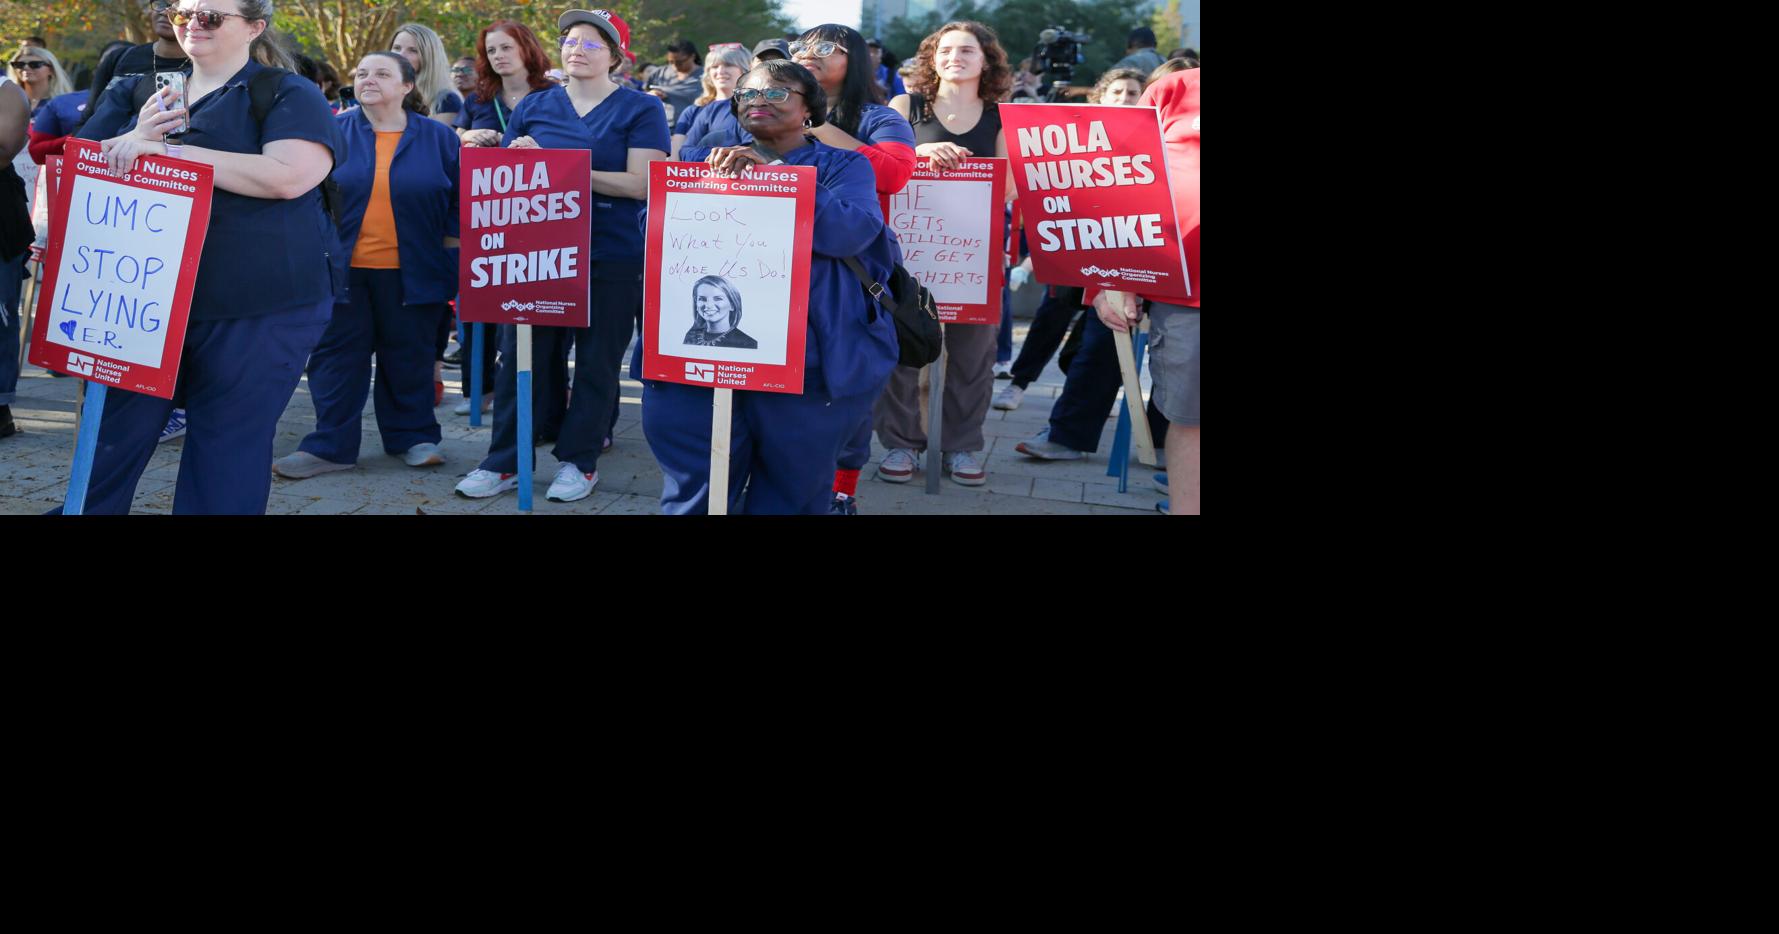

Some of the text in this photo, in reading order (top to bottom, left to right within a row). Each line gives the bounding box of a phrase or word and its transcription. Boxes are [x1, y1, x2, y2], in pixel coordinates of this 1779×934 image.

[1017, 120, 1112, 158] NOLA
[79, 148, 198, 181] Natl Nurses
[959, 162, 994, 170] urses
[1024, 154, 1155, 191] NURSES
[77, 162, 196, 192] Organig Committee
[471, 161, 550, 197] NOLA
[740, 169, 798, 182] Nurses
[912, 170, 993, 179] nizing Committee
[666, 180, 797, 193] Organizing Committee
[86, 191, 168, 232] UMC
[471, 191, 581, 229] NURSES
[1042, 196, 1071, 214] ON
[893, 212, 945, 231] GETS
[481, 232, 504, 250] ON
[1036, 213, 1165, 252] STRIKE
[669, 232, 767, 258] What You
[934, 249, 975, 262] GET
[72, 245, 164, 290] STOP
[470, 246, 578, 289] STRIKE
[61, 283, 160, 332] LYING
[82, 327, 122, 349] E.R.
[95, 366, 122, 377] Nurses
[96, 359, 129, 372] National
[717, 371, 747, 379] Nurses
[718, 365, 754, 373] National
[94, 372, 120, 383] United
[717, 378, 746, 386] United
